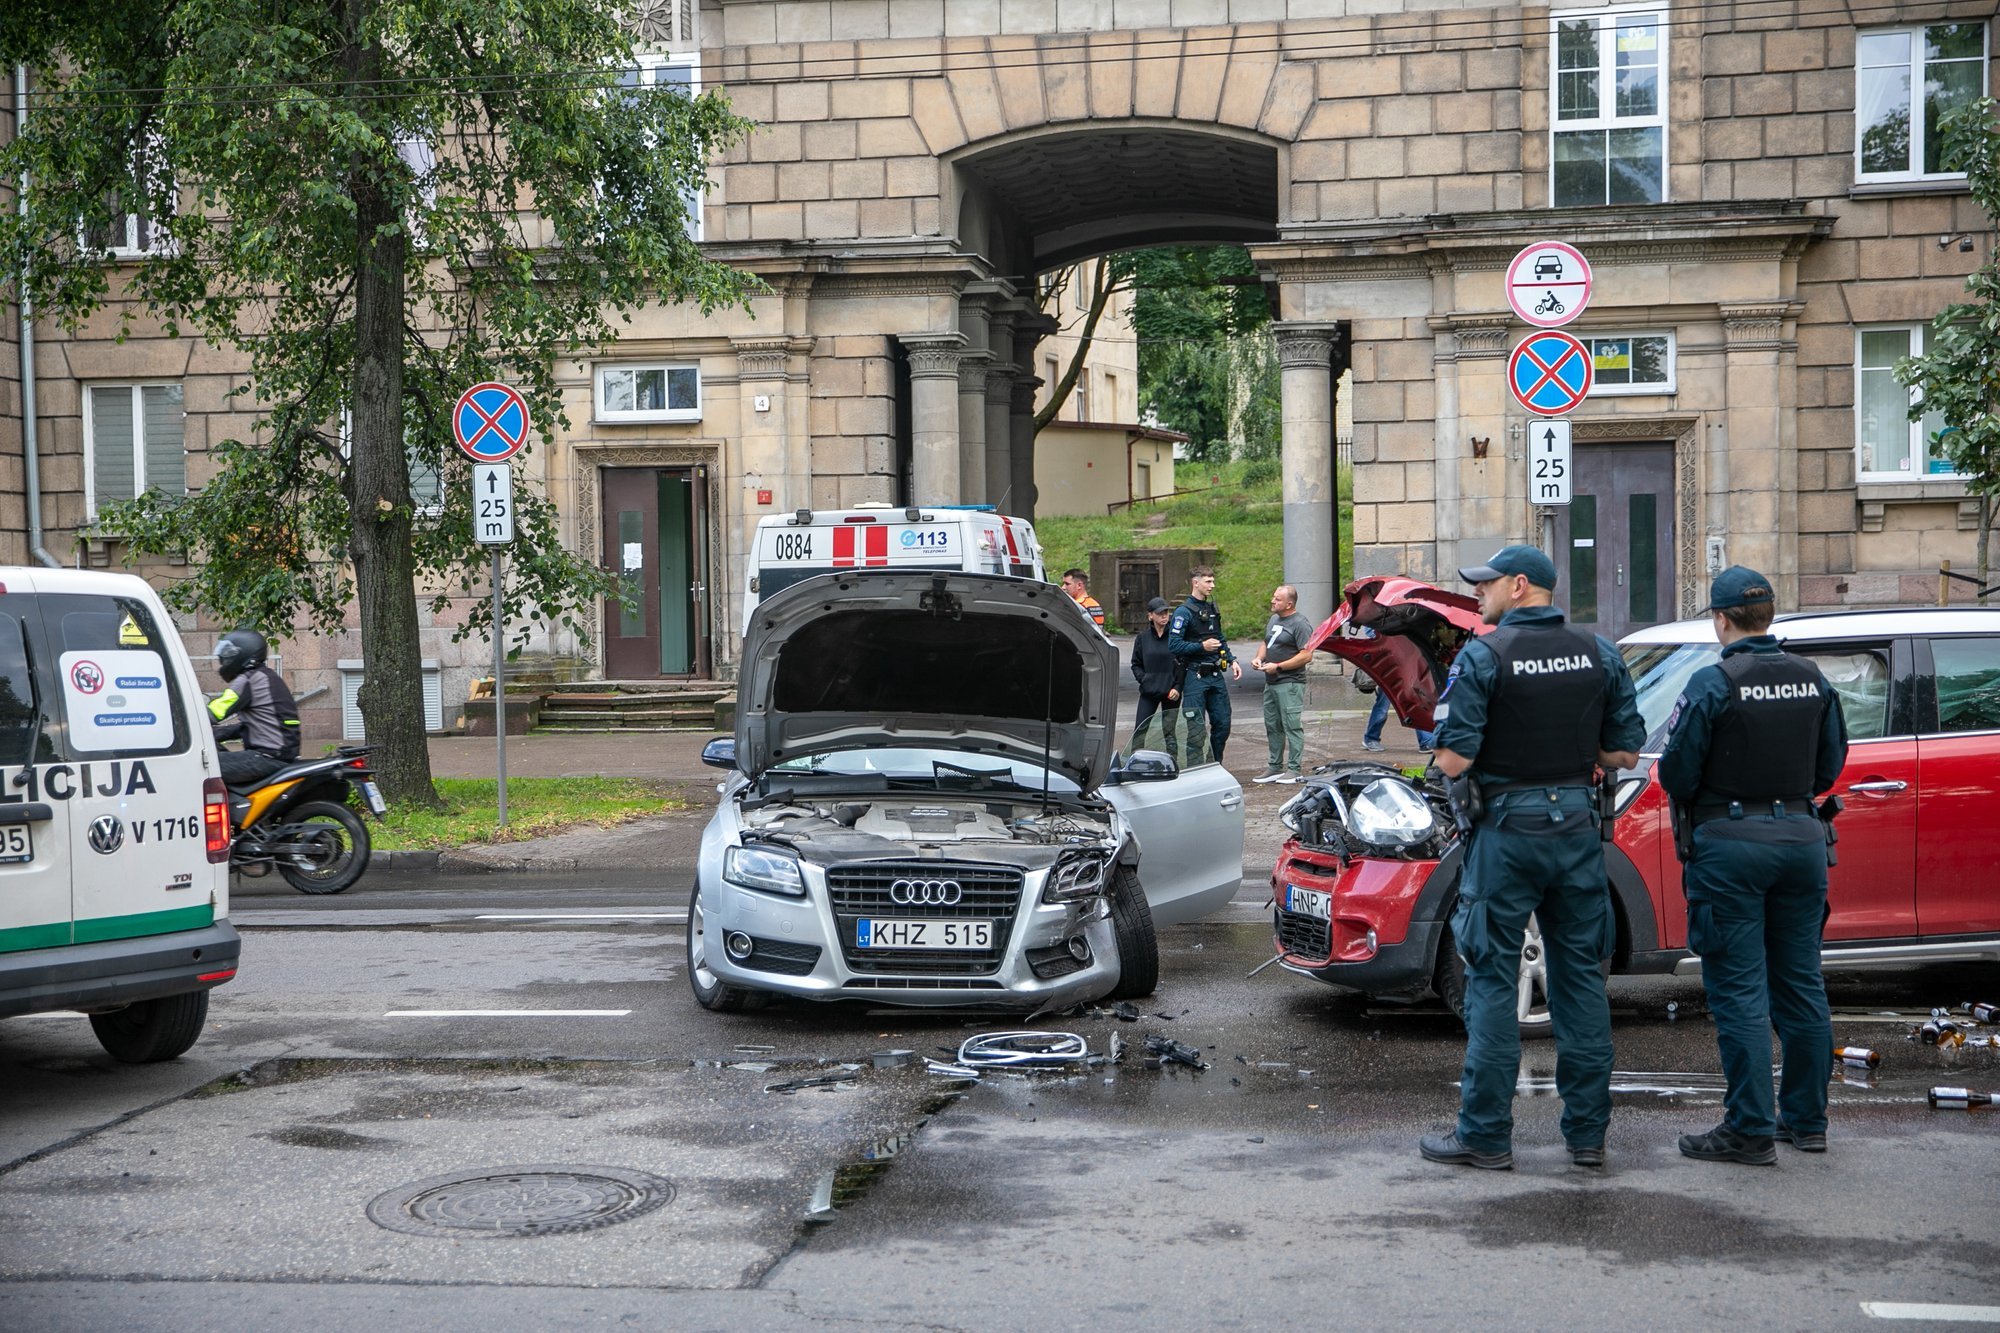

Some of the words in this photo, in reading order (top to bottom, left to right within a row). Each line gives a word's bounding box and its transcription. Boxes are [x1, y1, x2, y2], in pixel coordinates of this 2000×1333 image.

[758, 399, 765, 408] 4
[1536, 458, 1565, 478] 25
[1541, 484, 1560, 498] m
[480, 499, 506, 518] 25
[486, 522, 502, 536] m
[917, 531, 948, 546] 113
[775, 533, 812, 560] 0884
[1267, 624, 1284, 649] 7
[1512, 654, 1593, 676] POLICIJA
[1740, 682, 1820, 701] POLICIJA
[132, 820, 146, 844] V
[153, 815, 199, 842] 1716
[0, 827, 25, 854] 5
[173, 872, 192, 883] TDI
[1292, 889, 1319, 914] HNP
[859, 935, 870, 943] LT
[873, 923, 927, 945] KHZ
[944, 924, 988, 946] 515
